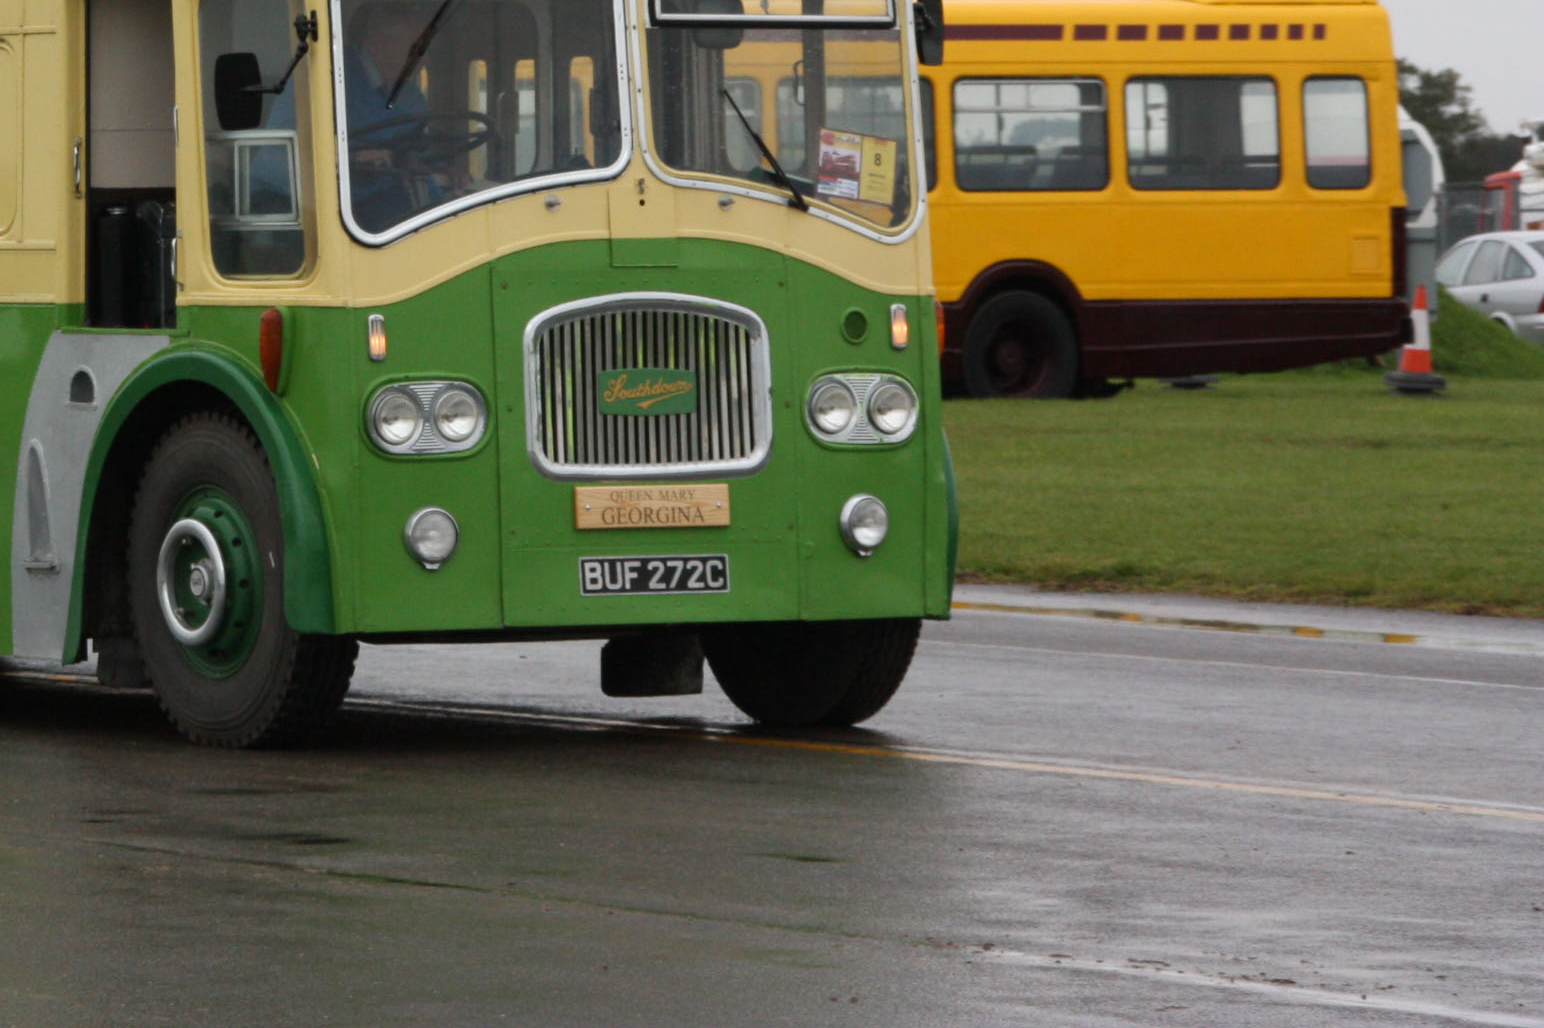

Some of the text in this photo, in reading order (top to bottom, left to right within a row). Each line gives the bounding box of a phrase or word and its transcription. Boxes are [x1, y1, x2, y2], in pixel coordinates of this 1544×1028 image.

[874, 153, 882, 166] 8
[603, 374, 693, 404] Southdown
[610, 489, 696, 502] QUEEN MARY
[601, 506, 705, 525] GEORGINA
[584, 560, 724, 590] BUF 272C
